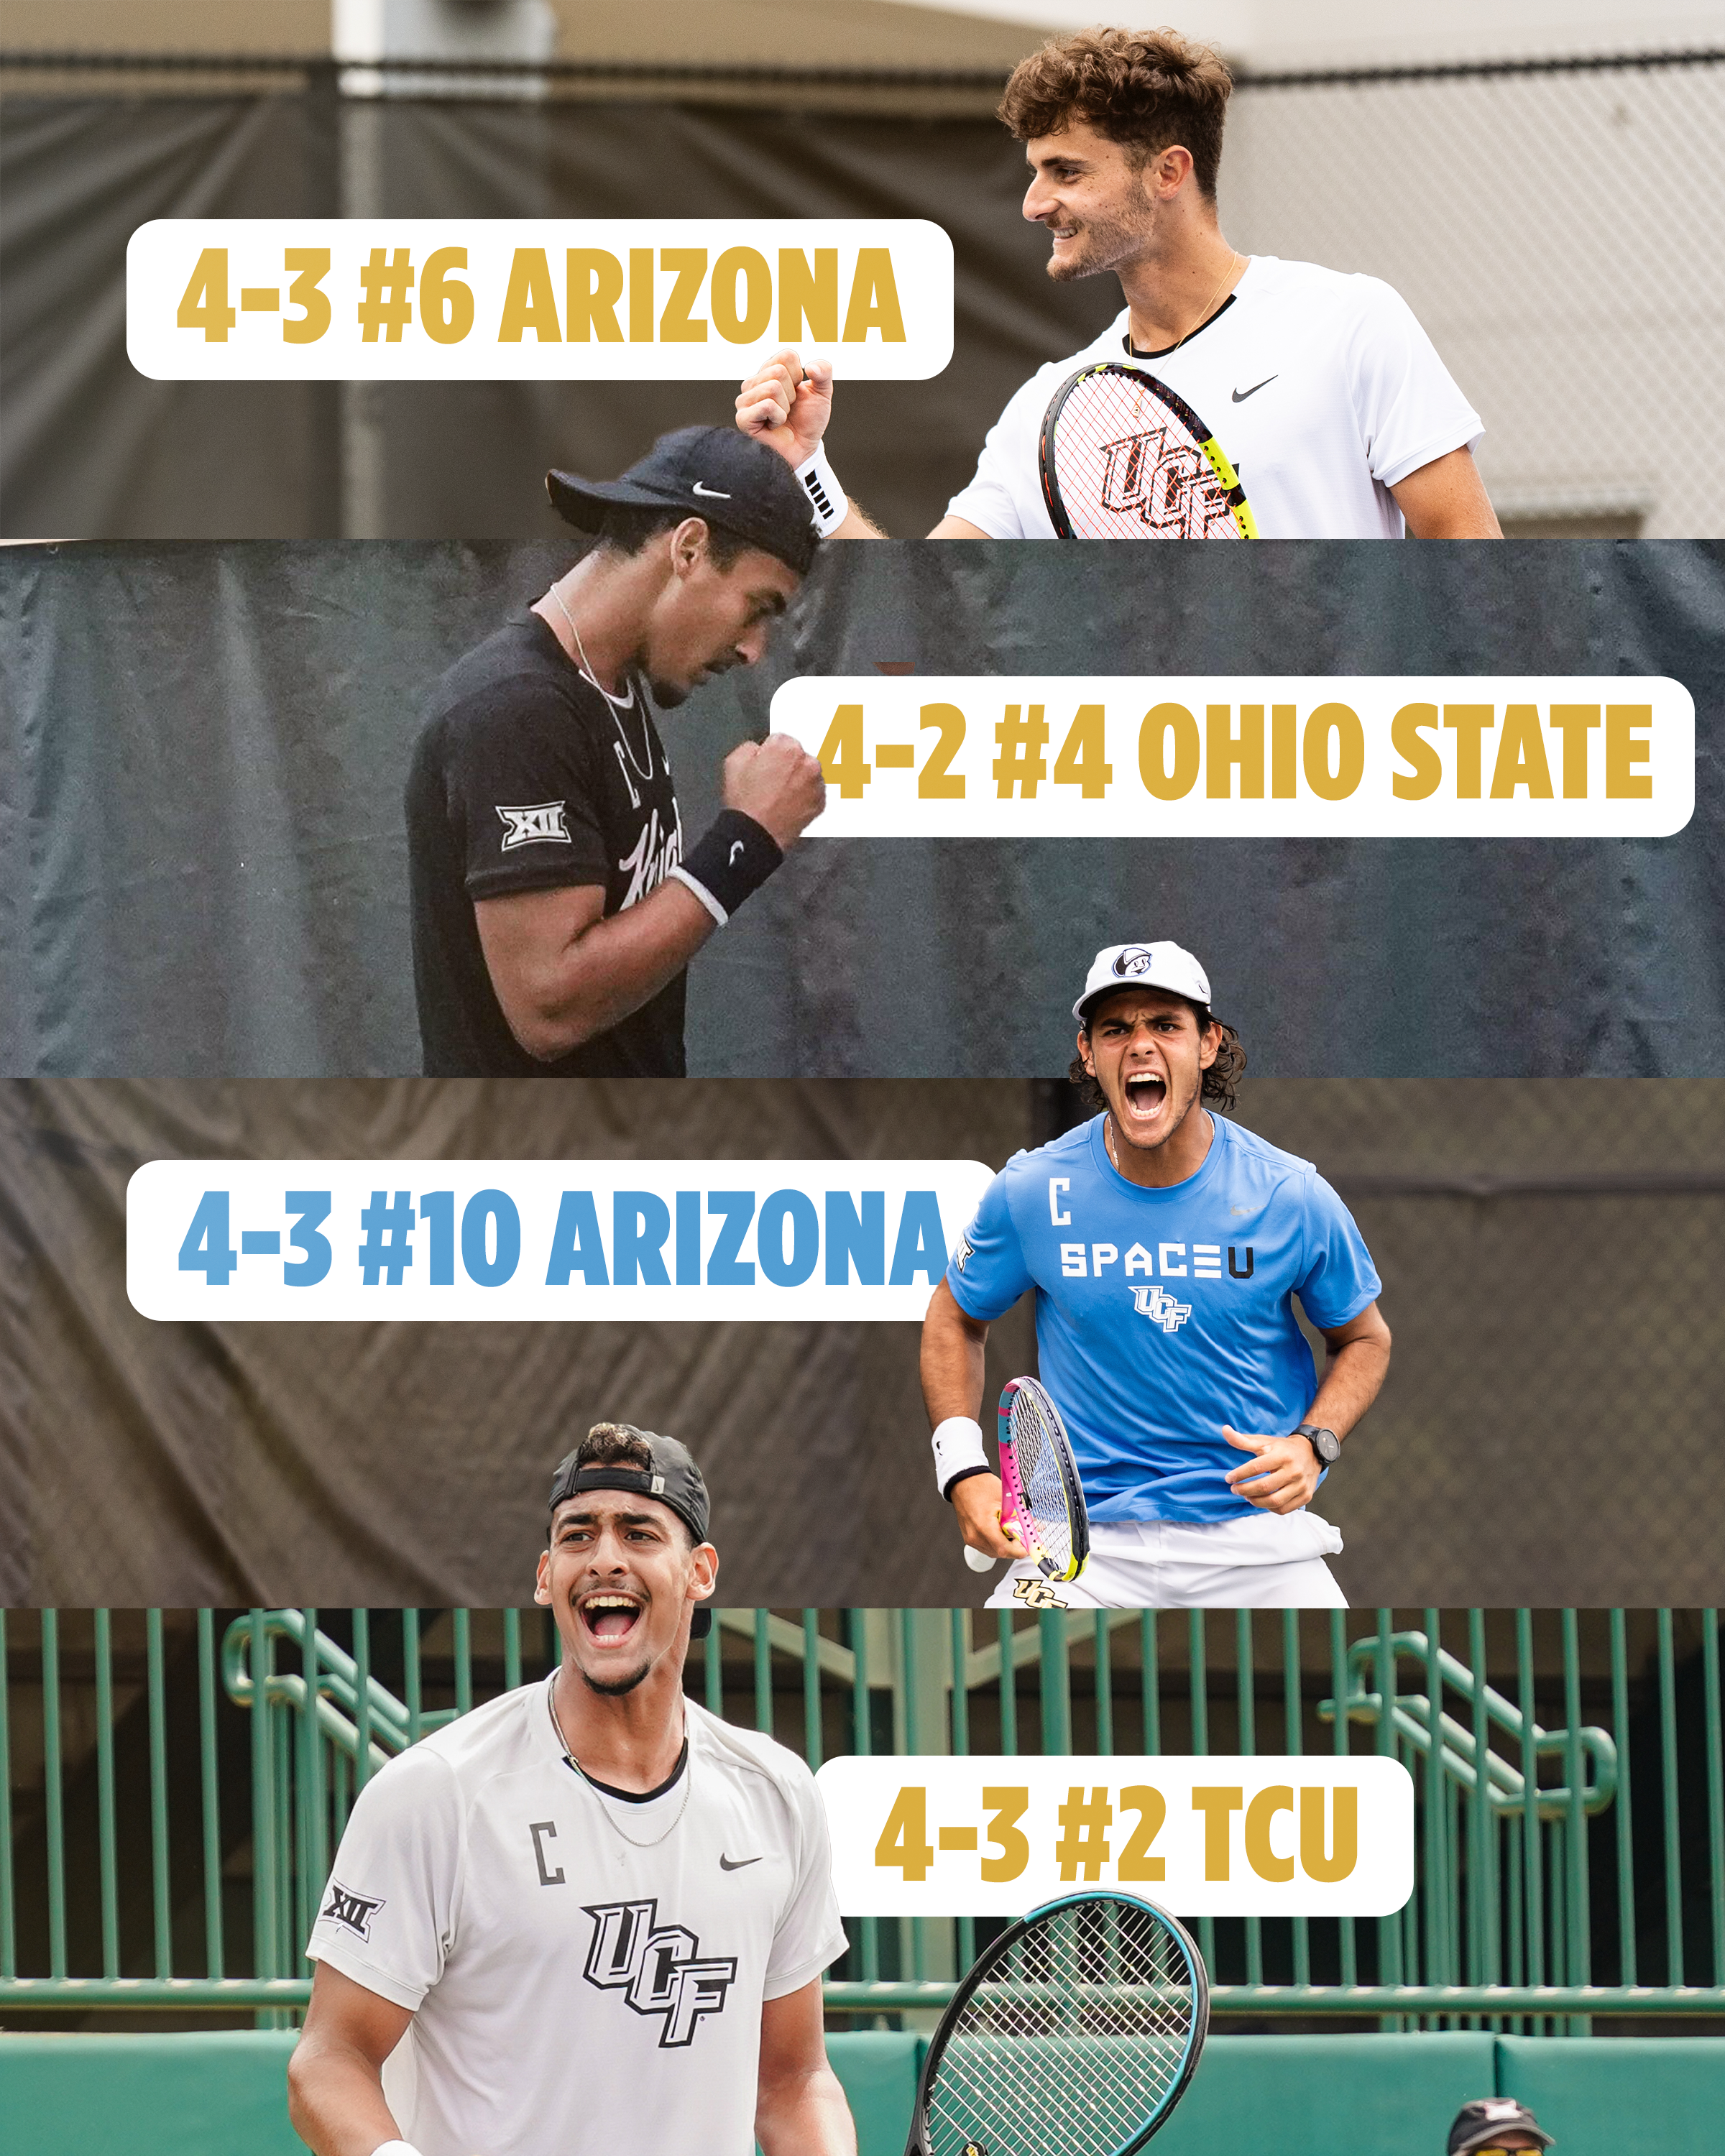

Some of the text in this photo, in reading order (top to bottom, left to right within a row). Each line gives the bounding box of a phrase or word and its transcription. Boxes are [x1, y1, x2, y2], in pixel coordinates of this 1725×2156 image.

[1049, 1178, 1072, 1226] C
[1128, 1285, 1192, 1332] UCF
[530, 1821, 565, 1886] C
[321, 1884, 380, 1935] XII
[579, 1899, 737, 2047] UCF
